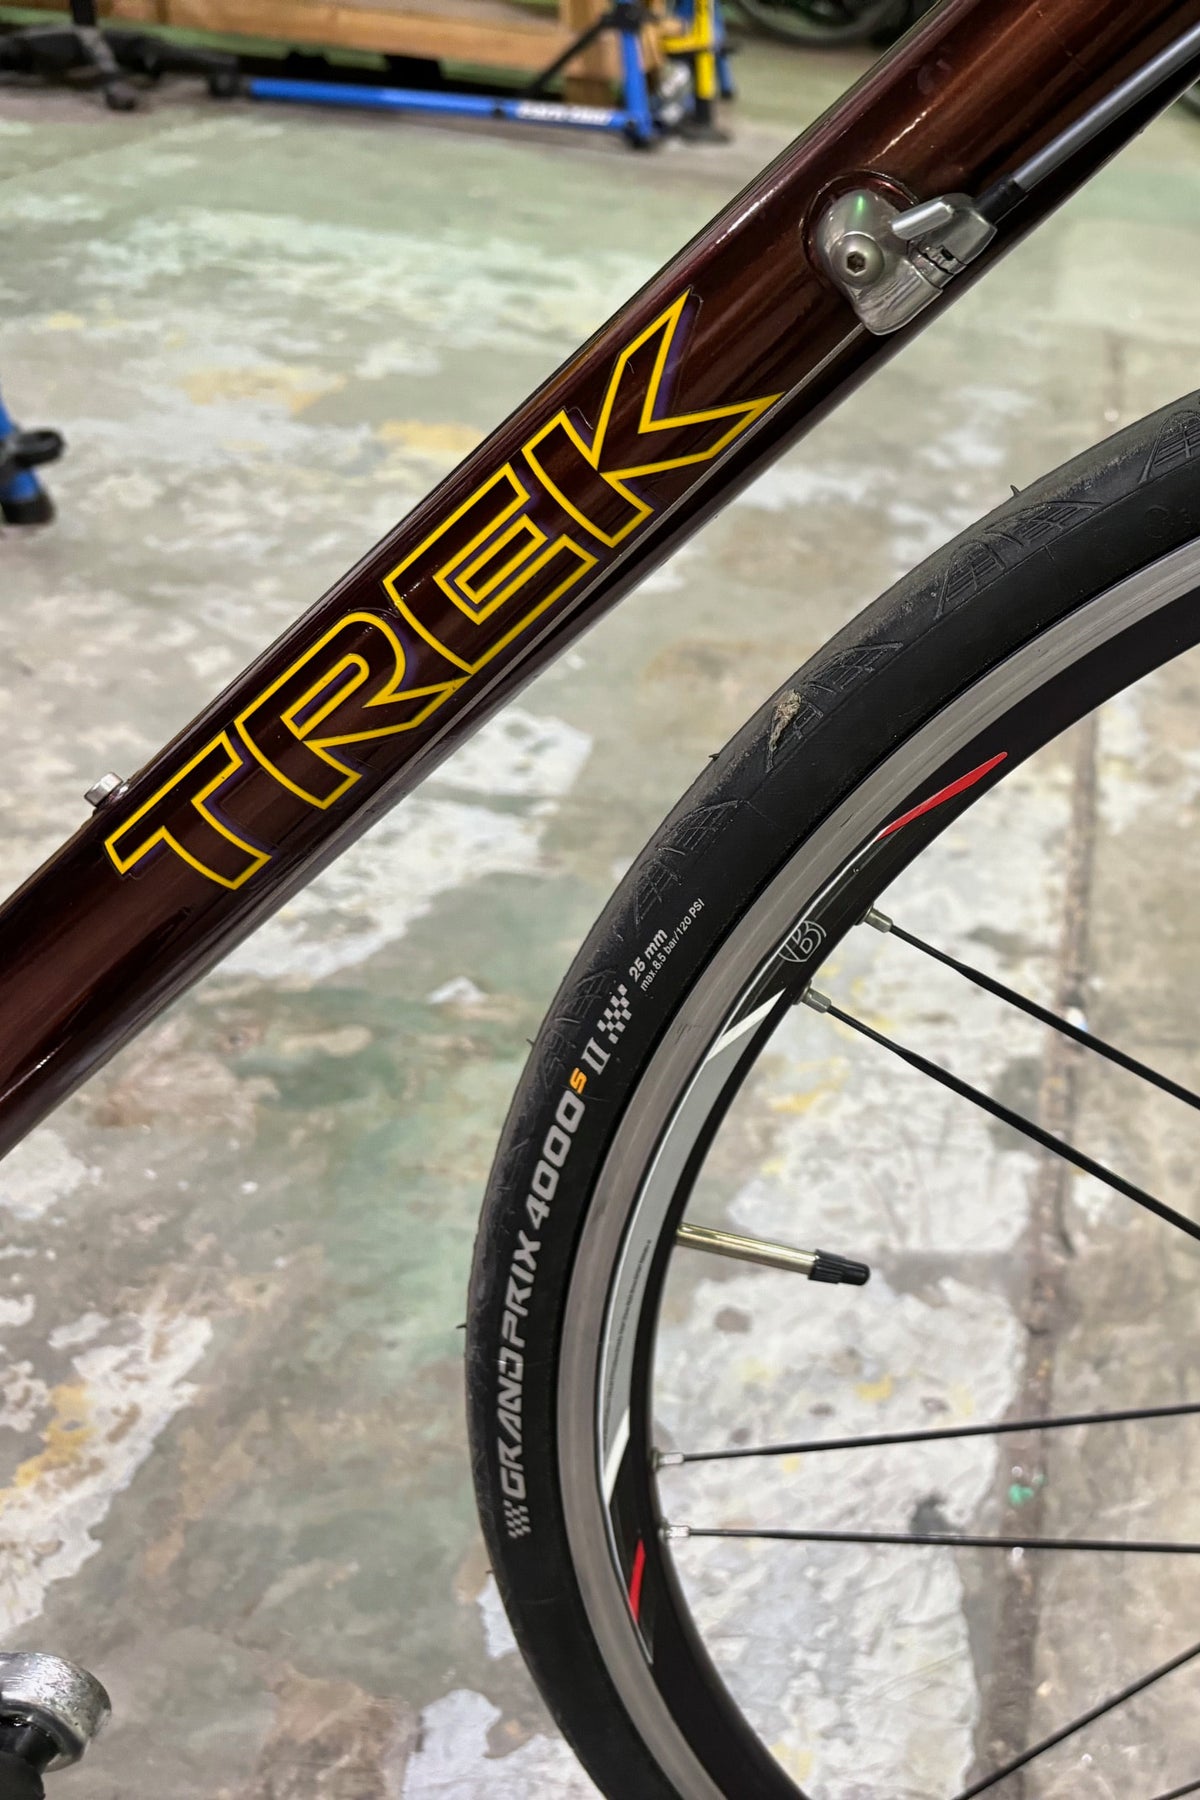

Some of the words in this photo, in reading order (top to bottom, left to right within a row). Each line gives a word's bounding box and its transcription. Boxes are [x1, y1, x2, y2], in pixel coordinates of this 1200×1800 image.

[104, 286, 785, 890] TREK
[663, 915, 692, 955] bar/120
[688, 898, 705, 918] PSI
[628, 956, 646, 982] 25
[644, 929, 668, 960] mm
